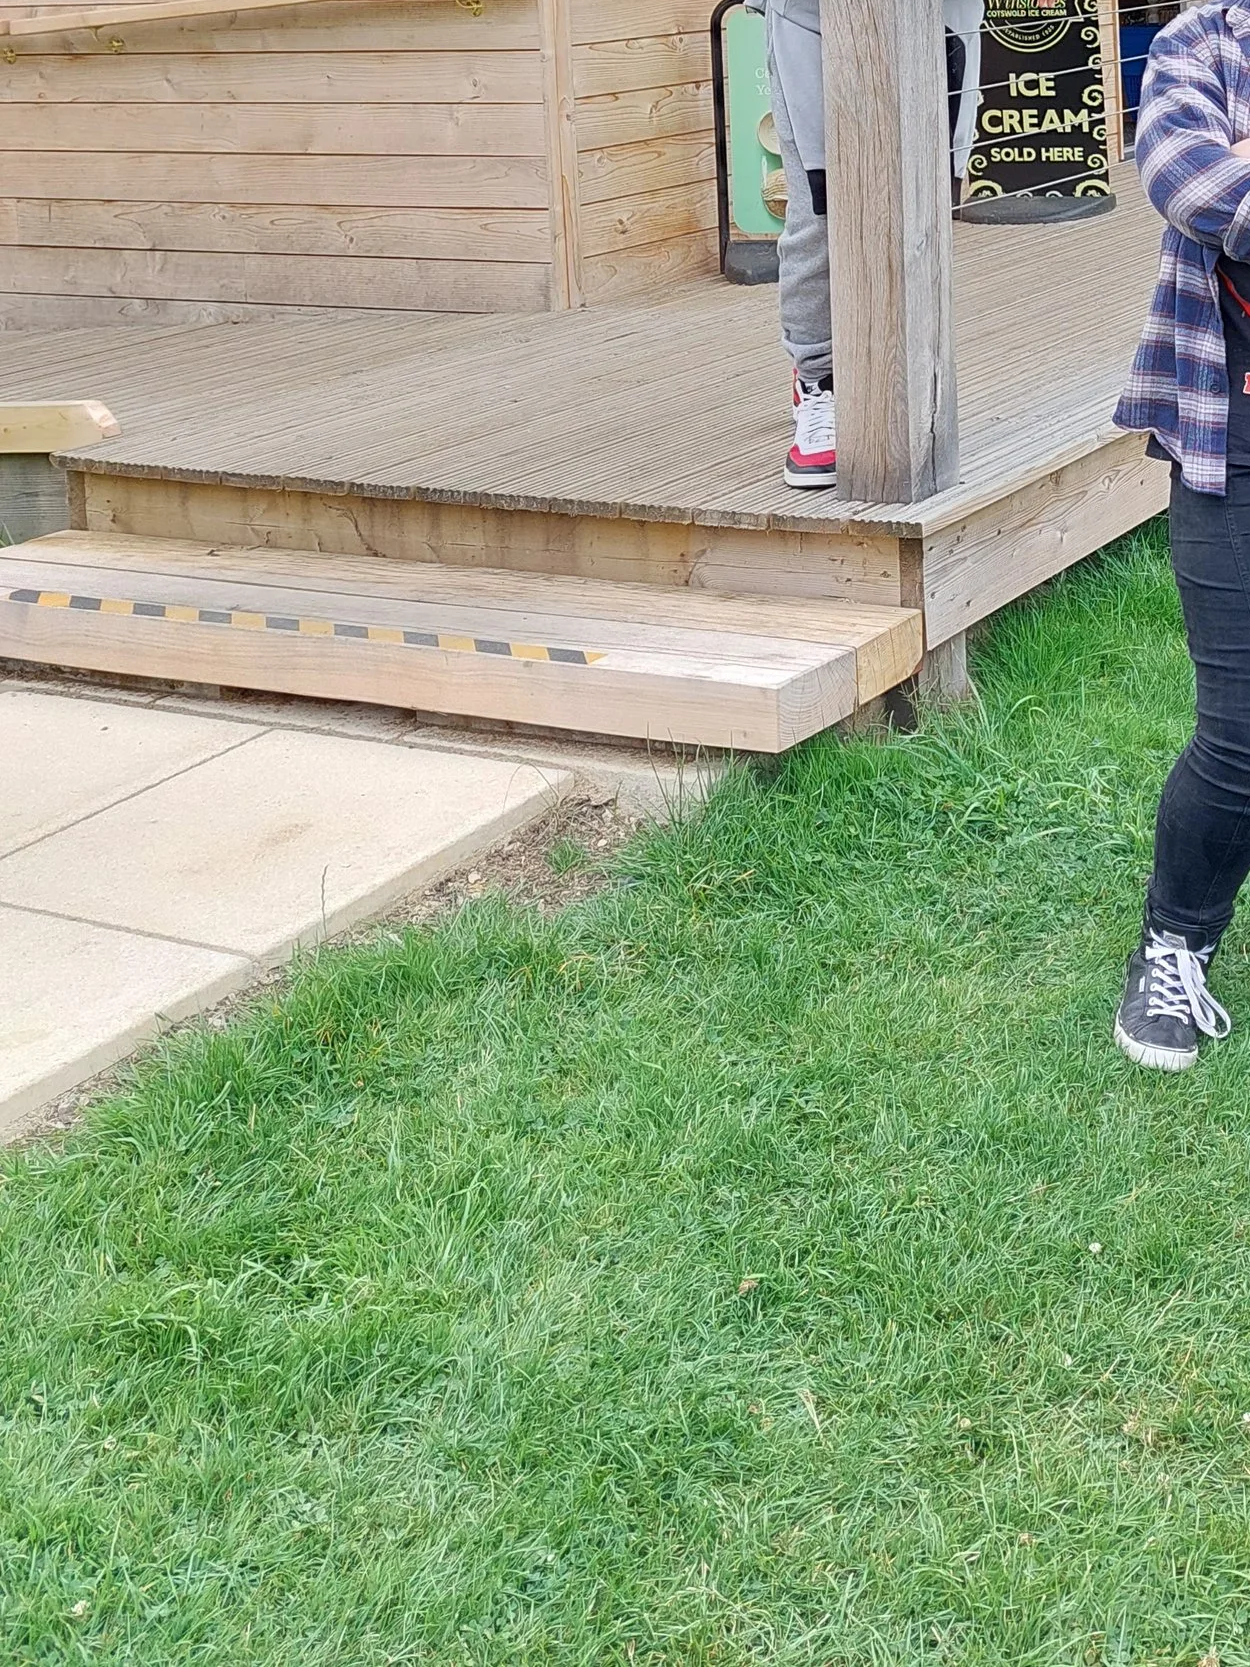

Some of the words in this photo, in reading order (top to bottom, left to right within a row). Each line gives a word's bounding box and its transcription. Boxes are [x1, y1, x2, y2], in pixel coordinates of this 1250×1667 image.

[986, 9, 1026, 18] COTSWOLD
[1028, 9, 1040, 17] ICE
[1041, 8, 1067, 17] CREAM
[1009, 72, 1056, 97] ICE
[981, 108, 1090, 134] CREAM
[990, 147, 1036, 162] SOLD
[1041, 147, 1084, 162] HERE
